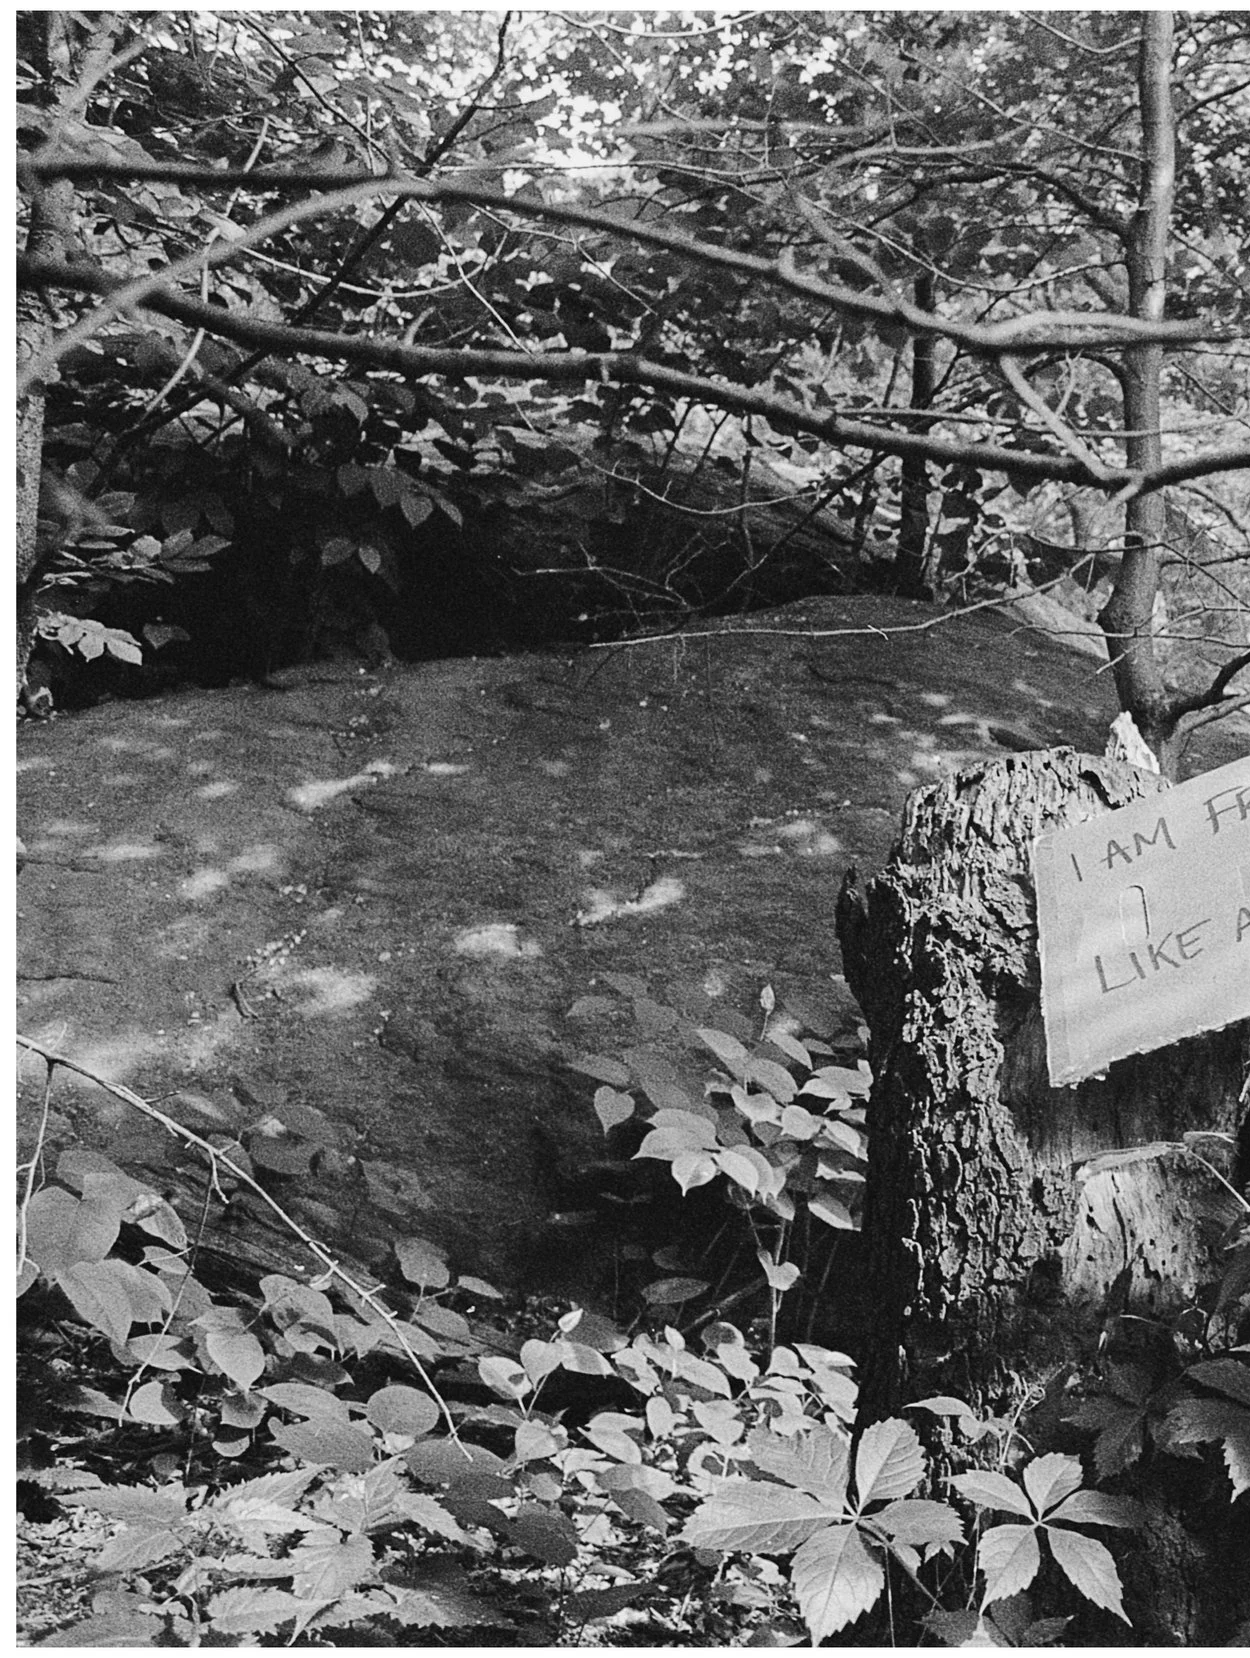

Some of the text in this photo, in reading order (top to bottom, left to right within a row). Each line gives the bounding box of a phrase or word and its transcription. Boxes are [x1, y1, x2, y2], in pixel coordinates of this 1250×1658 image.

[1070, 852, 1083, 882] I
[1101, 817, 1177, 869] AM
[1094, 918, 1212, 994] LIKE
